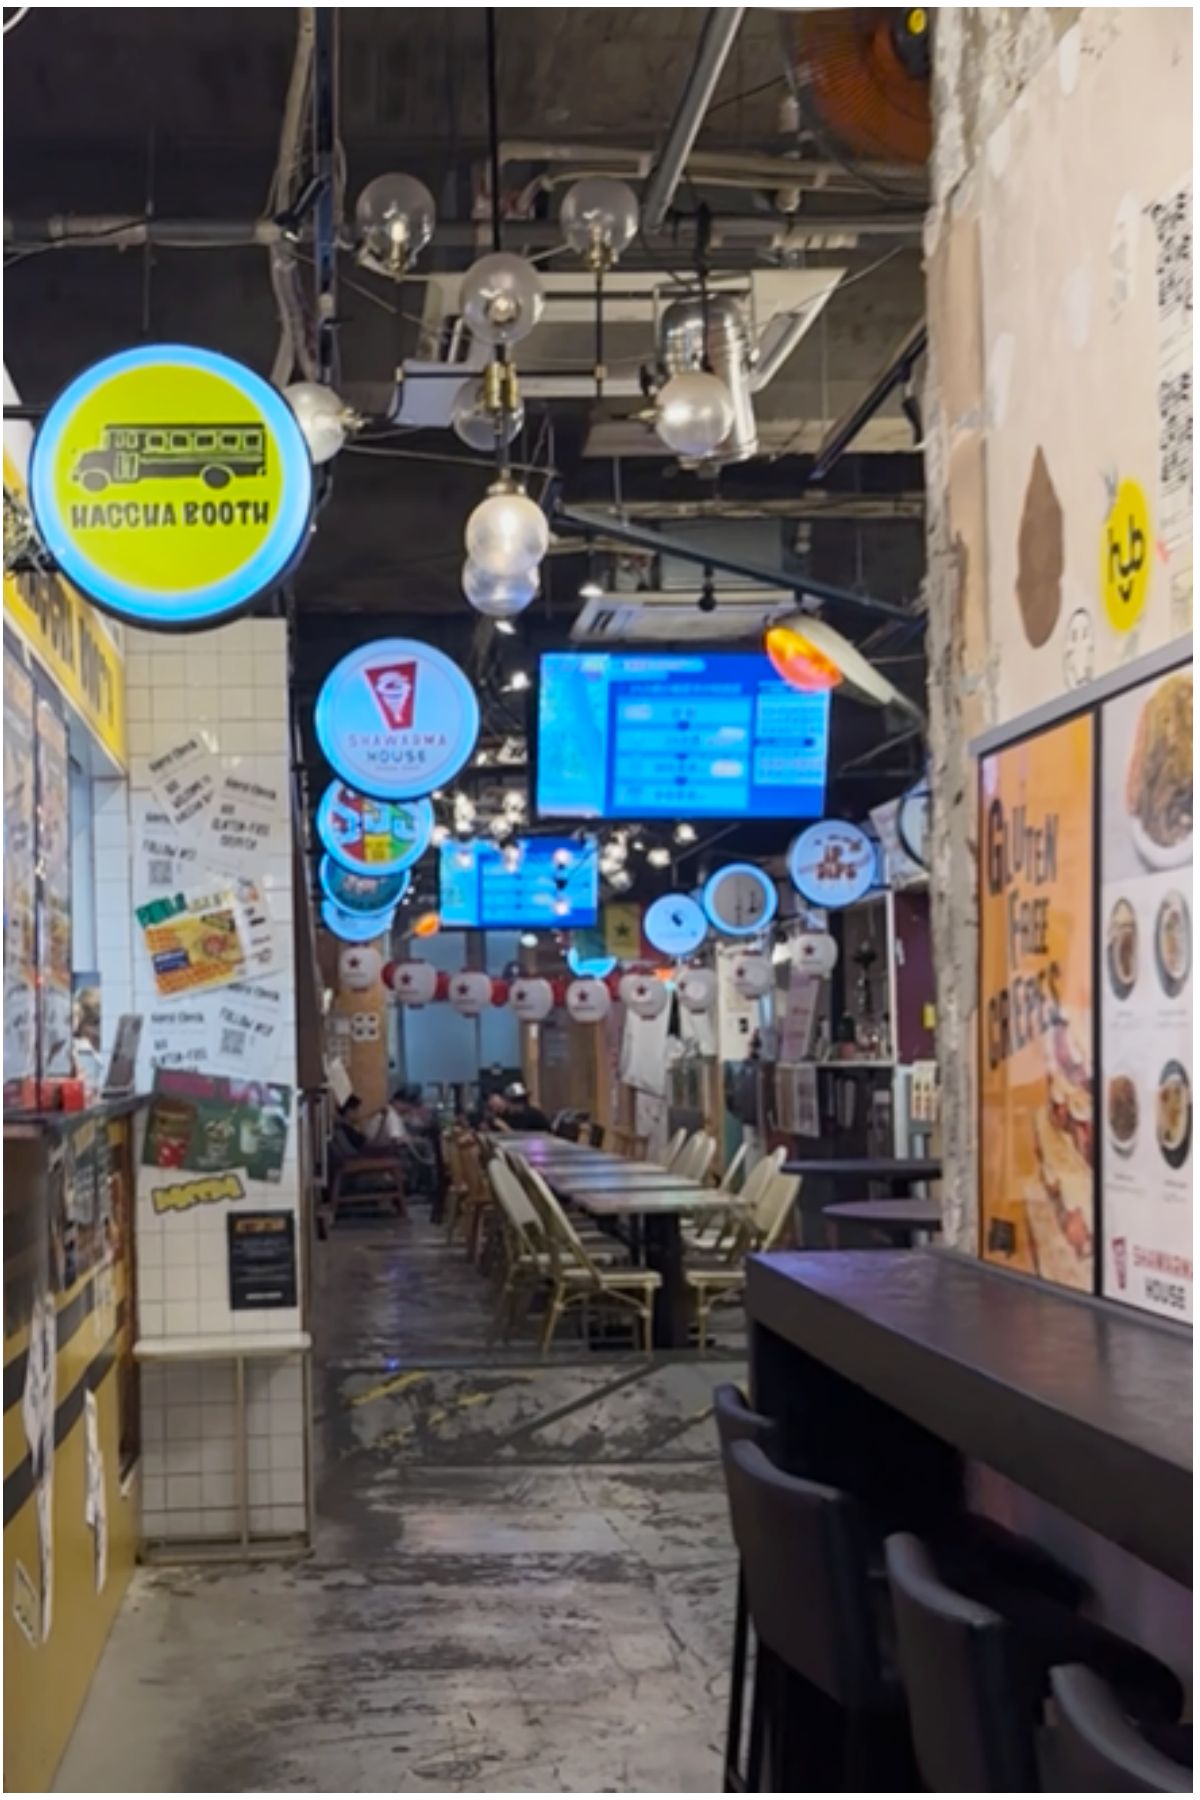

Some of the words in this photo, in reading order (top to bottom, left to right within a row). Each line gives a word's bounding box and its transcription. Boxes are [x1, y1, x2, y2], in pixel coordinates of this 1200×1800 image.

[71, 501, 177, 530] HACCHA
[182, 501, 270, 526] BOOTH
[367, 748, 427, 764] HOUSE
